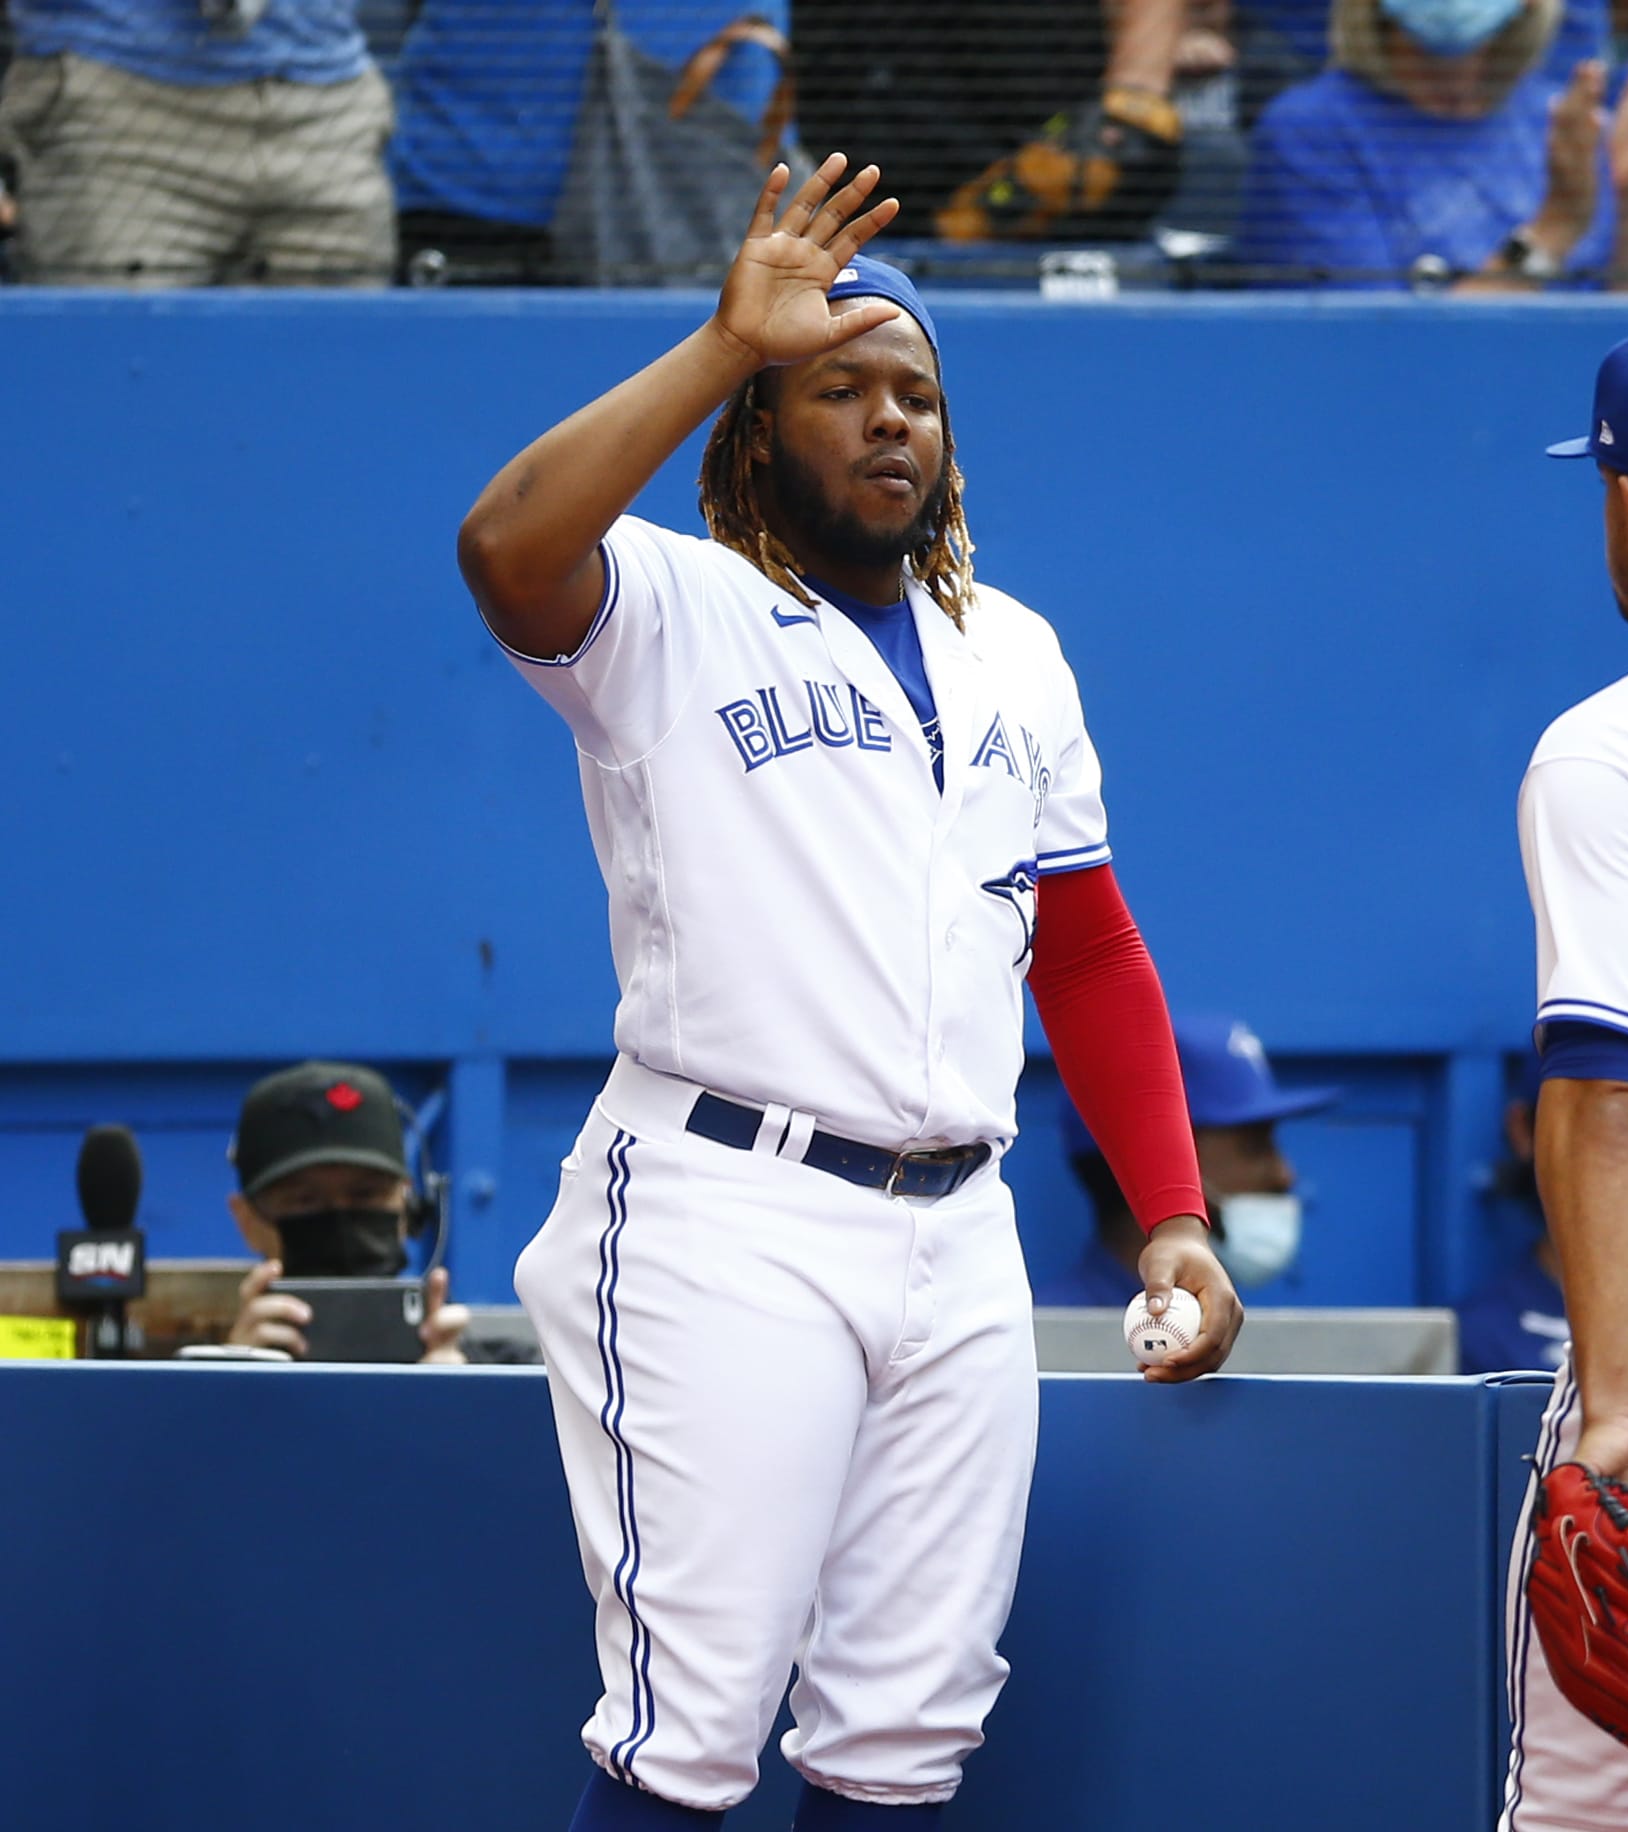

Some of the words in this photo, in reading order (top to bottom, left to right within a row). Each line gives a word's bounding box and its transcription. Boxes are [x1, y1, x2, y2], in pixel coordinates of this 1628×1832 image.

[714, 679, 892, 774] BLUE
[969, 710, 1052, 830] AYS
[69, 1240, 136, 1277] SN
